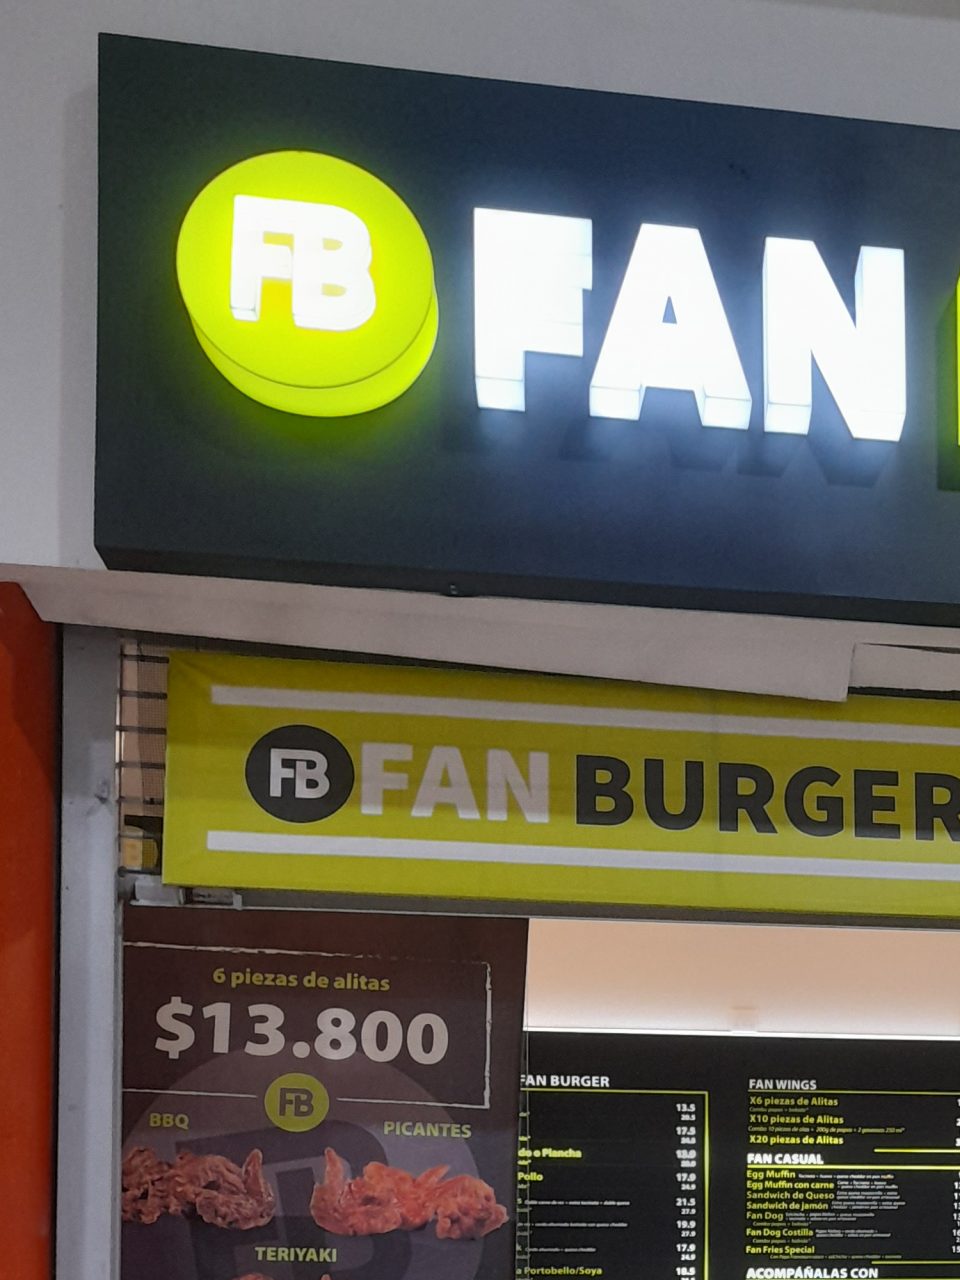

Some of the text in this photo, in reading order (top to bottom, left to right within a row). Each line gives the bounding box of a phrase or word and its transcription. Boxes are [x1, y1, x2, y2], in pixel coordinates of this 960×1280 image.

[230, 195, 376, 331] FB
[474, 207, 906, 442] FAN
[269, 748, 331, 799] FB
[360, 741, 550, 823] FAN
[212, 968, 390, 992] 6 piezas de alitas
[154, 996, 449, 1065] $13.800
[550, 1075, 610, 1087] BURGER
[749, 1079, 817, 1090] FAN WINGS
[278, 1087, 314, 1118] FB
[750, 1096, 838, 1106] X6 piezas de Alitas
[149, 1112, 189, 1130] BBQ
[750, 1114, 844, 1125] X10 piezas de Alitas
[383, 1121, 472, 1139] PICANTES
[749, 1135, 844, 1145] X20 piezas de Alitas
[747, 1153, 824, 1165] FAN CASUAL
[517, 1172, 544, 1181] Pollo
[746, 1170, 764, 1179] Egg
[766, 1170, 796, 1178] Muffin
[746, 1181, 763, 1190] Egg
[764, 1180, 794, 1189] Muffin
[746, 1191, 791, 1200] Sandwich
[792, 1191, 804, 1200] de
[806, 1191, 835, 1201] Queso
[746, 1201, 800, 1210] Sandwich de
[765, 1212, 783, 1221] Dog
[746, 1229, 762, 1237] Fan
[763, 1229, 781, 1238] Dog
[782, 1228, 814, 1237] Costilla
[254, 1246, 337, 1263] TERIYAKI
[784, 1246, 815, 1255] Special
[524, 1266, 603, 1276] Portobello/Soya
[746, 1265, 879, 1279] ACOMPÁÑALAS CON
